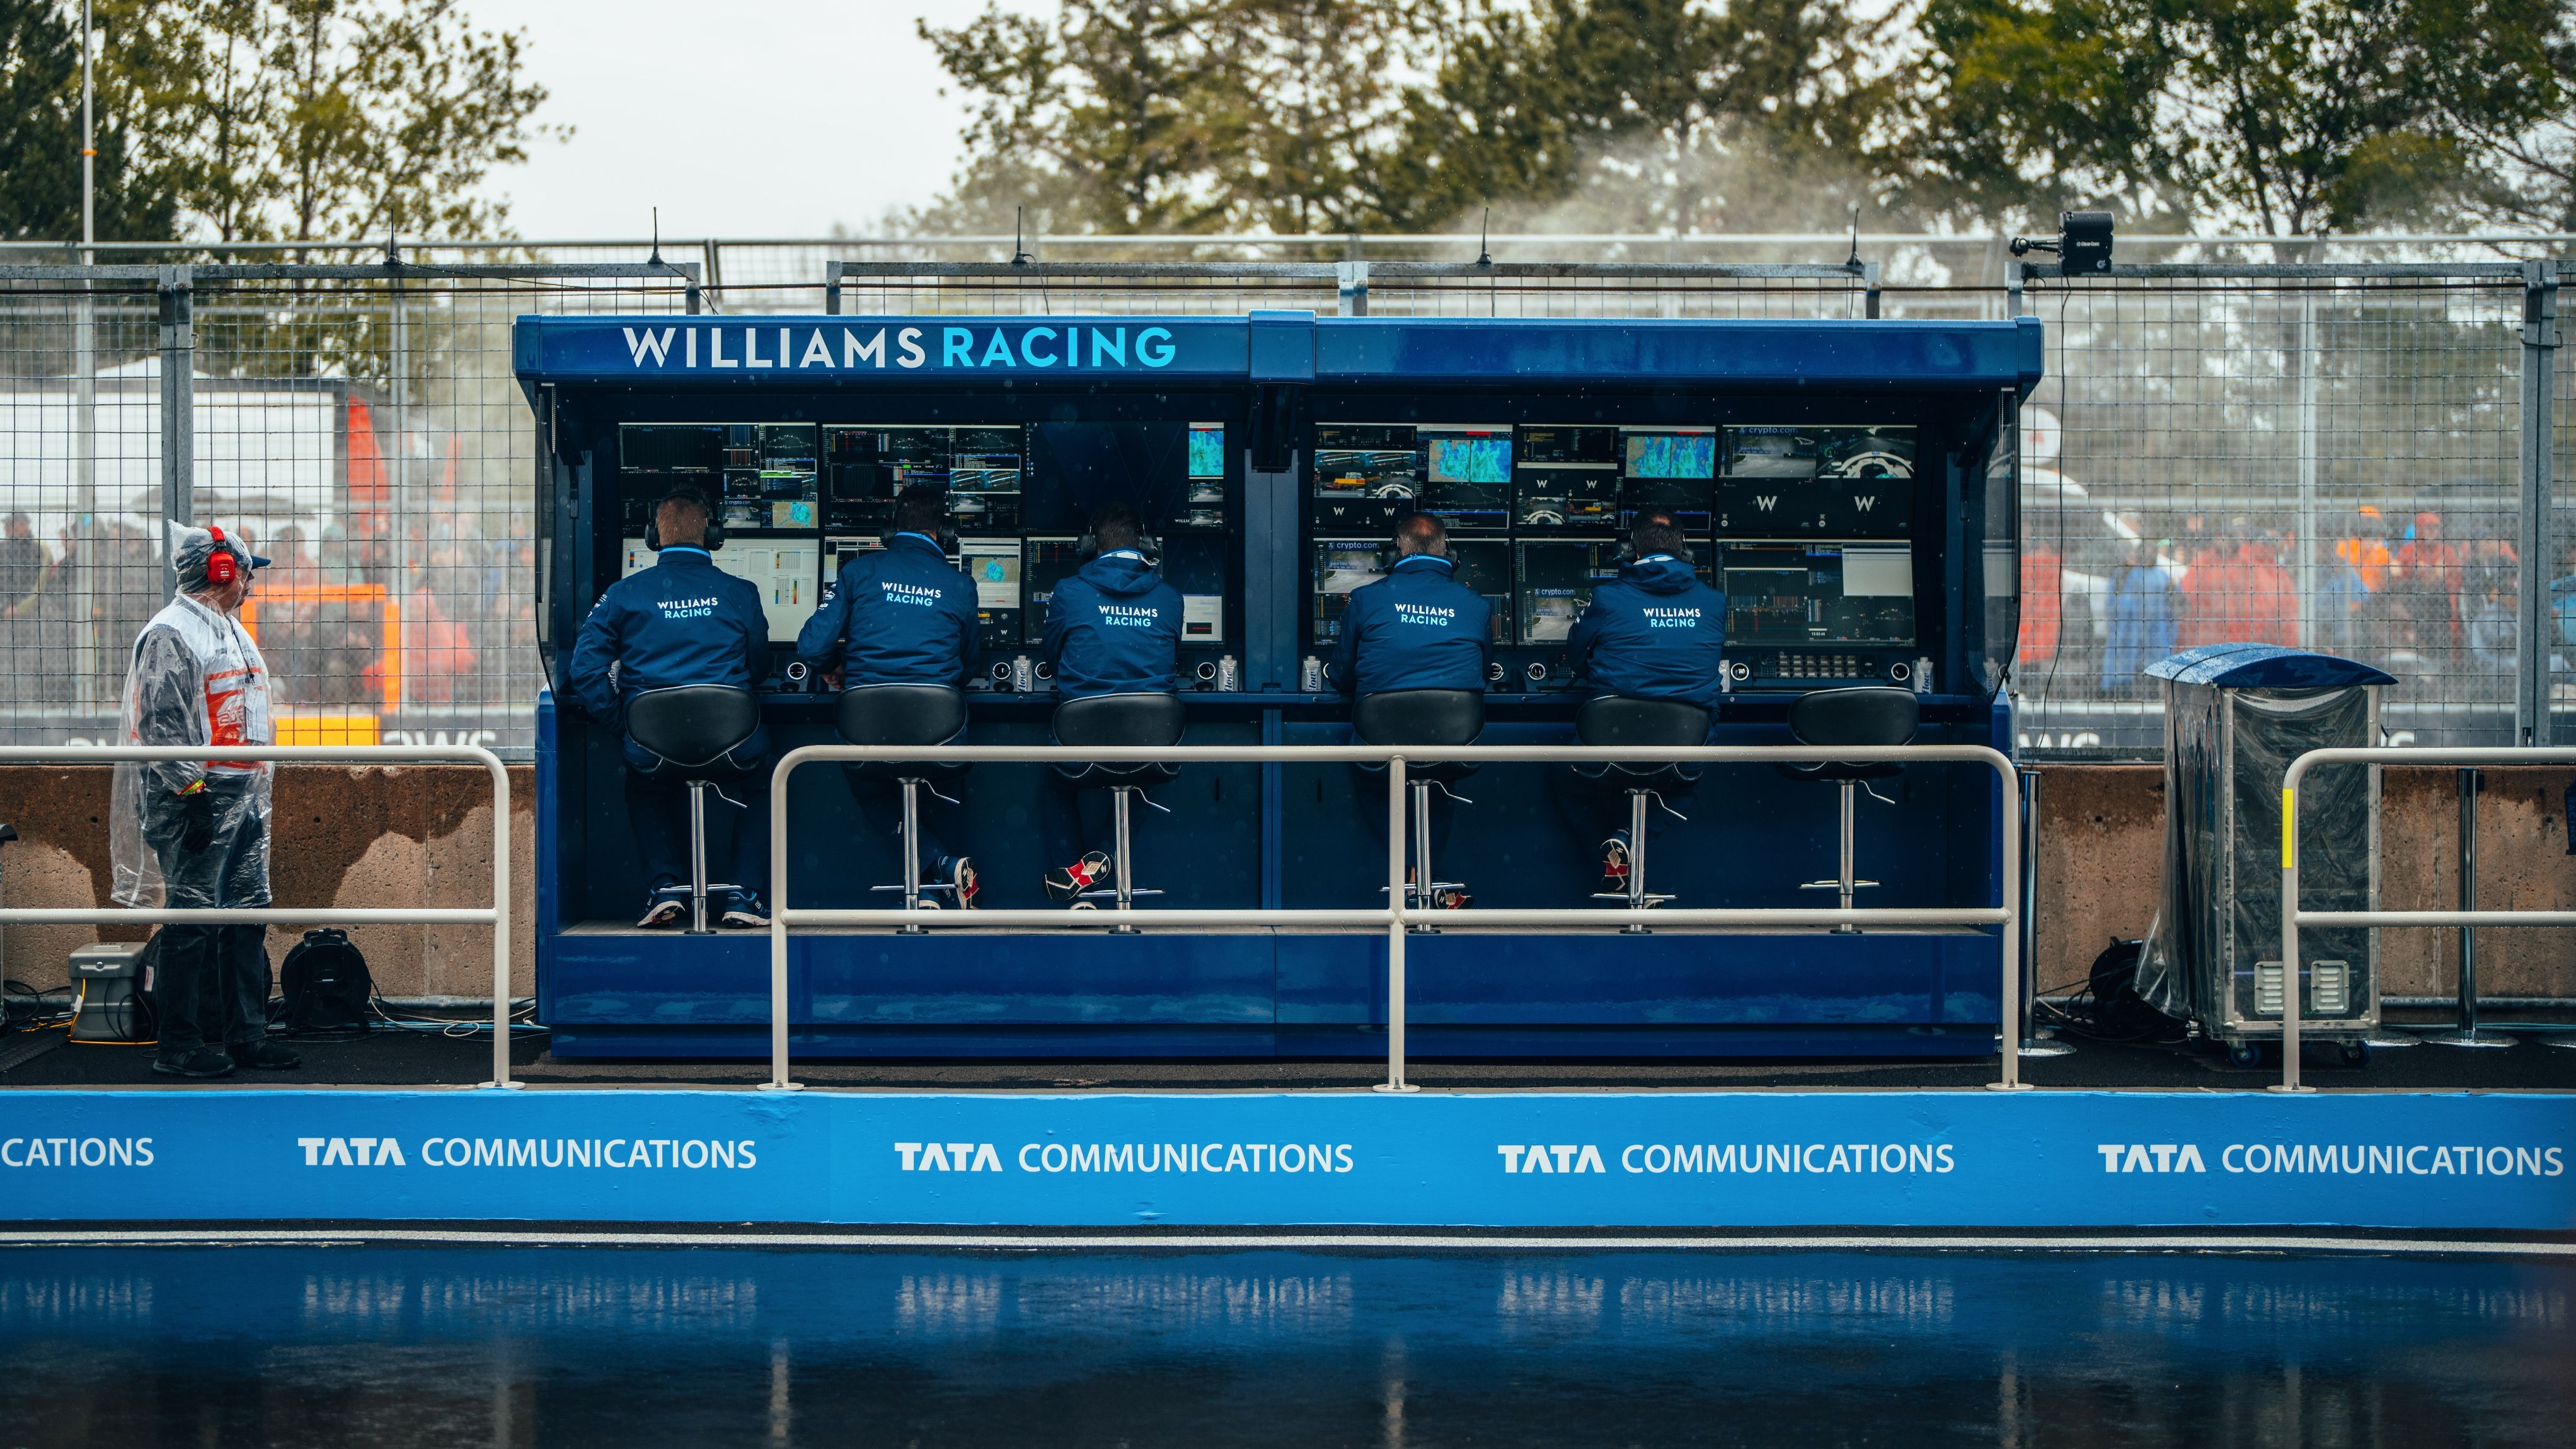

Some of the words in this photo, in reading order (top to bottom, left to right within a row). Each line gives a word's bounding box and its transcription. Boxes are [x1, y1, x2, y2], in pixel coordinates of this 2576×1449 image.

[623, 326, 926, 368] WILLIAMS
[943, 326, 1176, 367] RACING
[1749, 426, 1798, 437] crypto.com
[1538, 480, 1548, 488] W
[1587, 480, 1597, 489] W
[1757, 495, 1778, 511] W
[1854, 496, 1875, 512] W
[1333, 507, 1345, 516] W
[1384, 507, 1395, 516] W
[1337, 541, 1380, 550] crypto.com
[882, 582, 941, 599] WILLIAMS
[1541, 588, 1576, 596] crypto.com
[657, 597, 718, 609] WILLIAMS
[887, 592, 933, 607] RACING
[665, 608, 711, 619] RACING
[1098, 605, 1158, 618] WILLIAMS
[1394, 603, 1455, 618] WILLIAMS
[1643, 608, 1701, 618] WILLIAMS
[1106, 616, 1151, 627] RACING
[1401, 614, 1448, 626] RACING
[1651, 618, 1696, 628] RACING
[1, 1138, 154, 1167] CATIONS
[297, 1138, 406, 1166] TATA
[422, 1138, 757, 1169] COMMUNICATIONS
[894, 1142, 1003, 1172] TATA
[1018, 1143, 1354, 1173] COMMUNICATIONS
[1497, 1145, 1606, 1173] TATA
[1621, 1144, 1954, 1173] COMMUNICATIONS
[2098, 1144, 2206, 1172] TATA
[2222, 1144, 2563, 1176] COMMUNICATIONS
